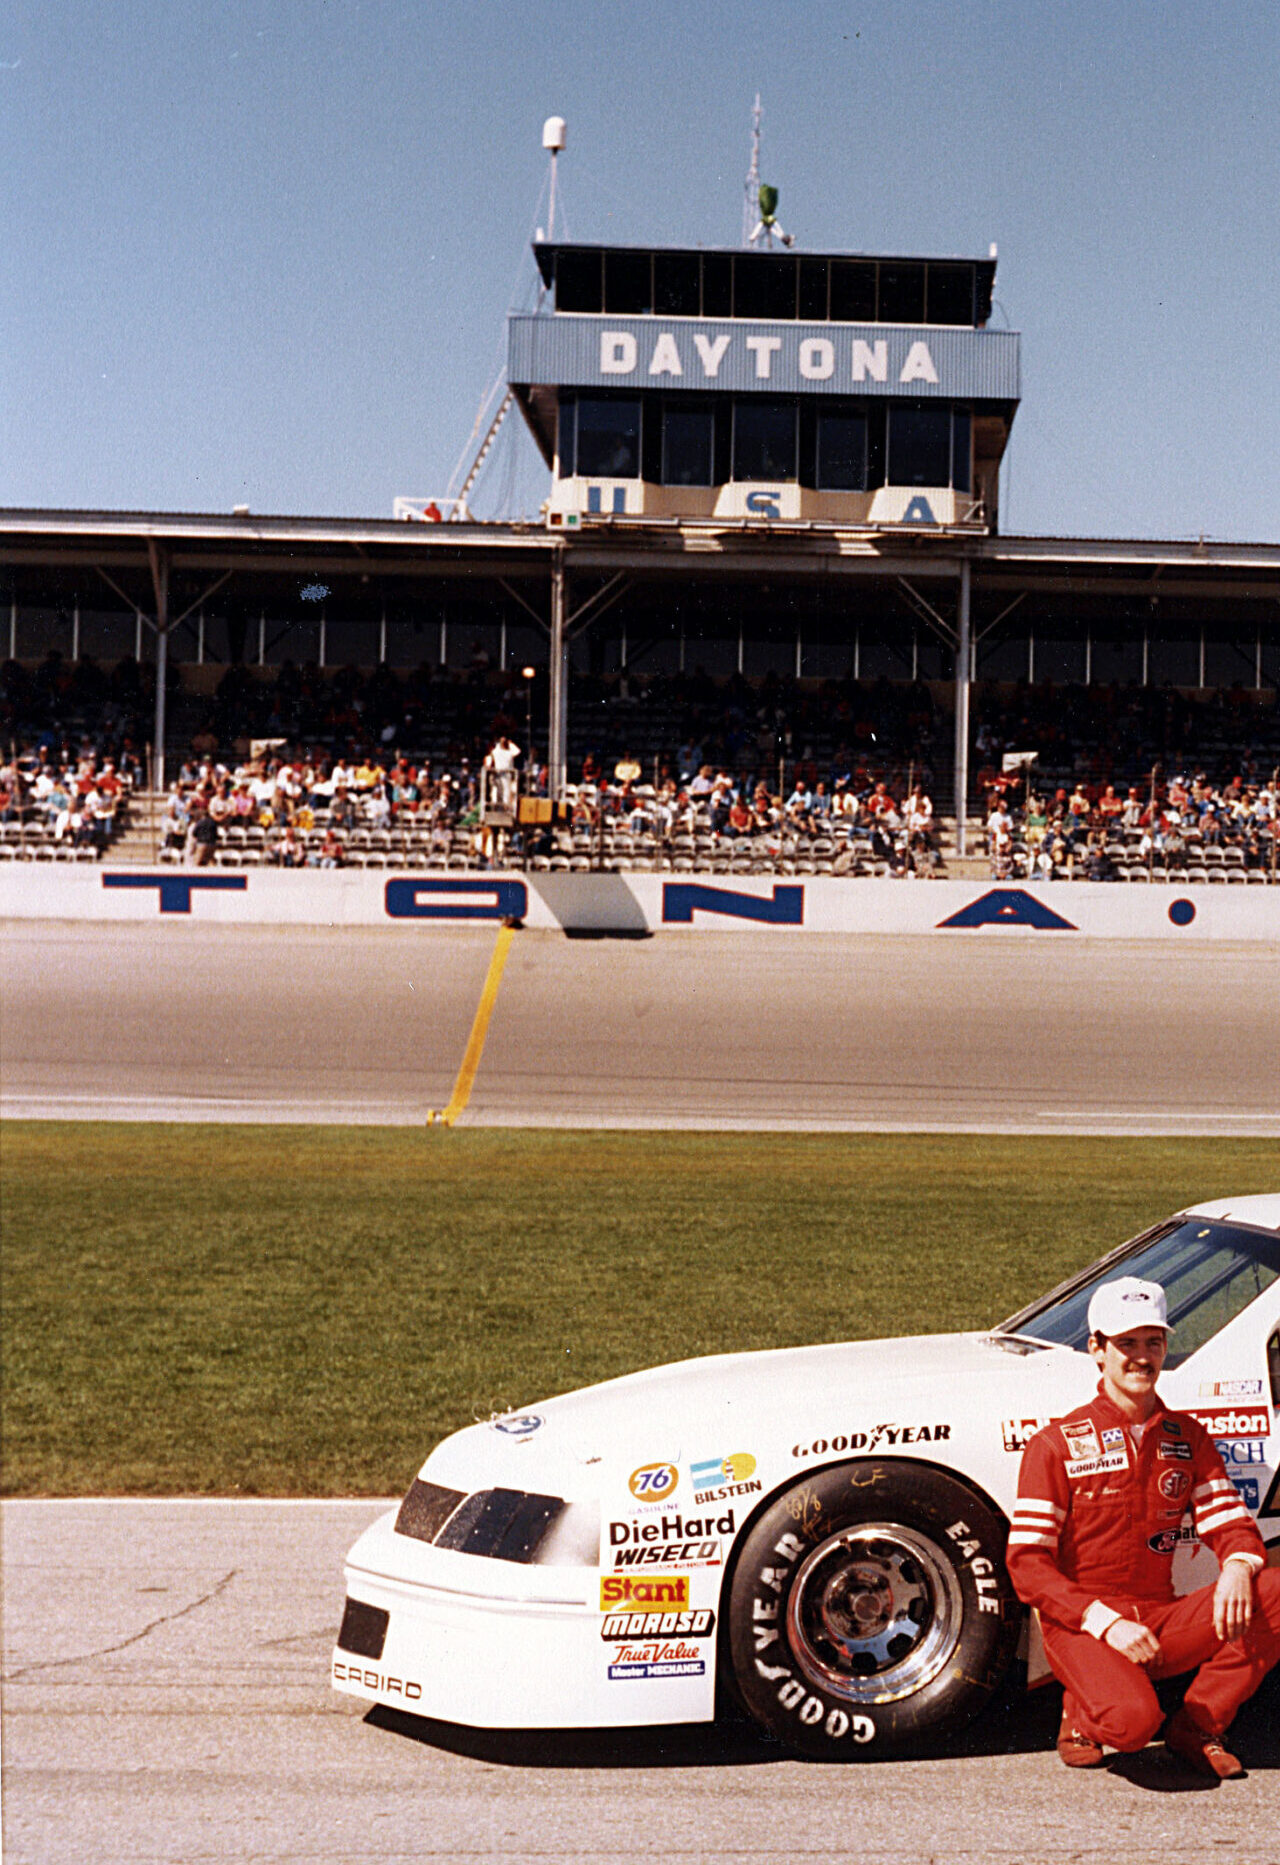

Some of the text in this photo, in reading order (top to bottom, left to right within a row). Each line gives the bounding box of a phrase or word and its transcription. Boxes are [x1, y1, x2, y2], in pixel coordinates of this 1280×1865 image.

[600, 330, 939, 384] DAYTONA
[1188, 1411, 1268, 1435] nston
[791, 1424, 951, 1457] GOODYEAR
[1216, 1441, 1266, 1465] SCH
[638, 1468, 671, 1492] 76
[694, 1480, 763, 1505] BILSTEIN
[609, 1509, 736, 1546] DieHard
[614, 1541, 719, 1567] WISECO
[944, 1520, 1000, 1615] EAGLE
[603, 1578, 686, 1603] Stant
[601, 1610, 716, 1641] MOROSO
[752, 1532, 876, 1744] GOODYEAR
